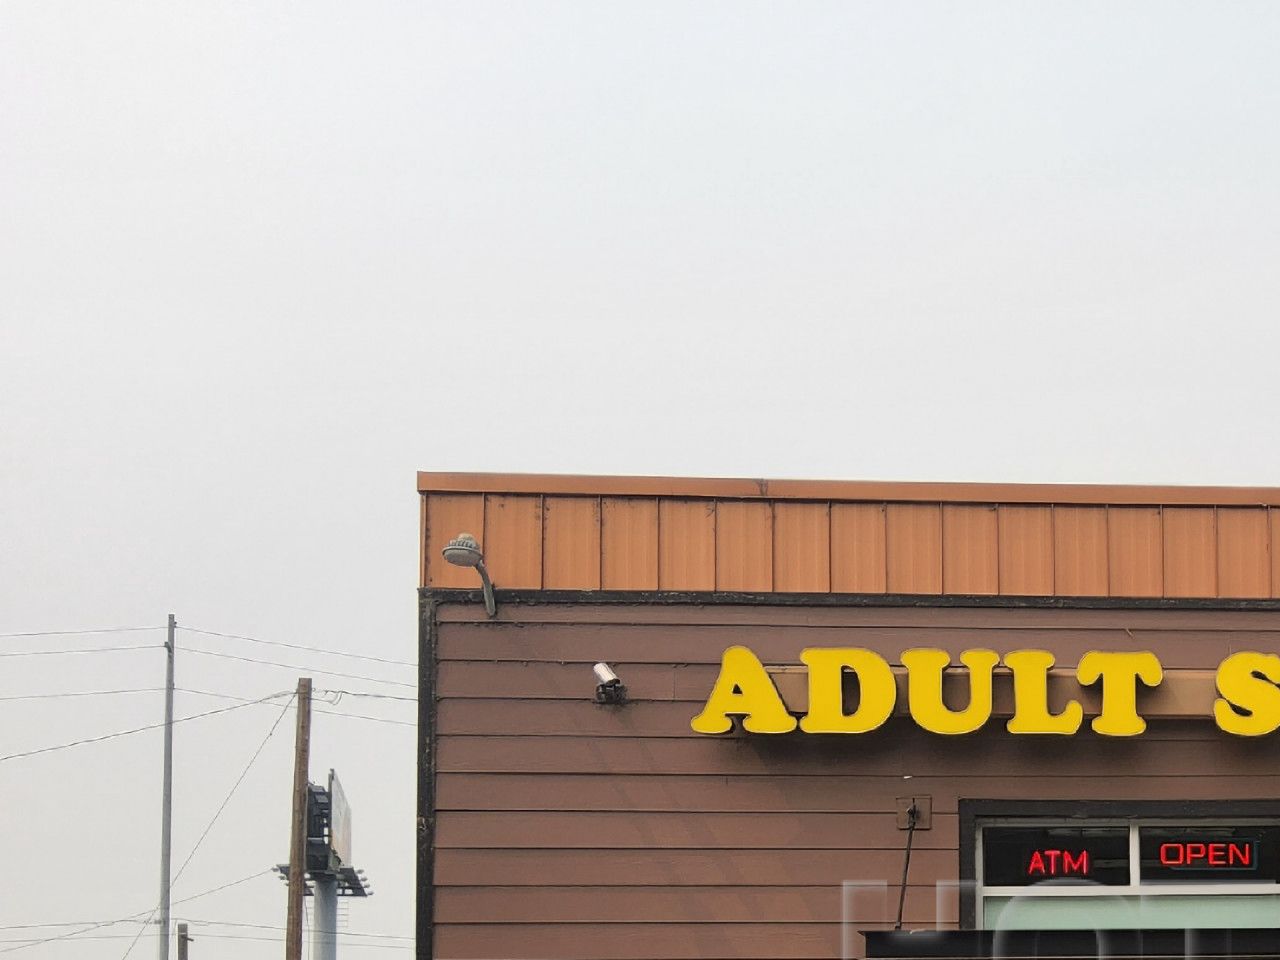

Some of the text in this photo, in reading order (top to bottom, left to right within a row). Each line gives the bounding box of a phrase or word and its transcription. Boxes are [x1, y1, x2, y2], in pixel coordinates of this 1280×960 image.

[690, 644, 1163, 736] ADULT
[1028, 849, 1089, 875] ATM
[1160, 843, 1251, 866] OPEN
